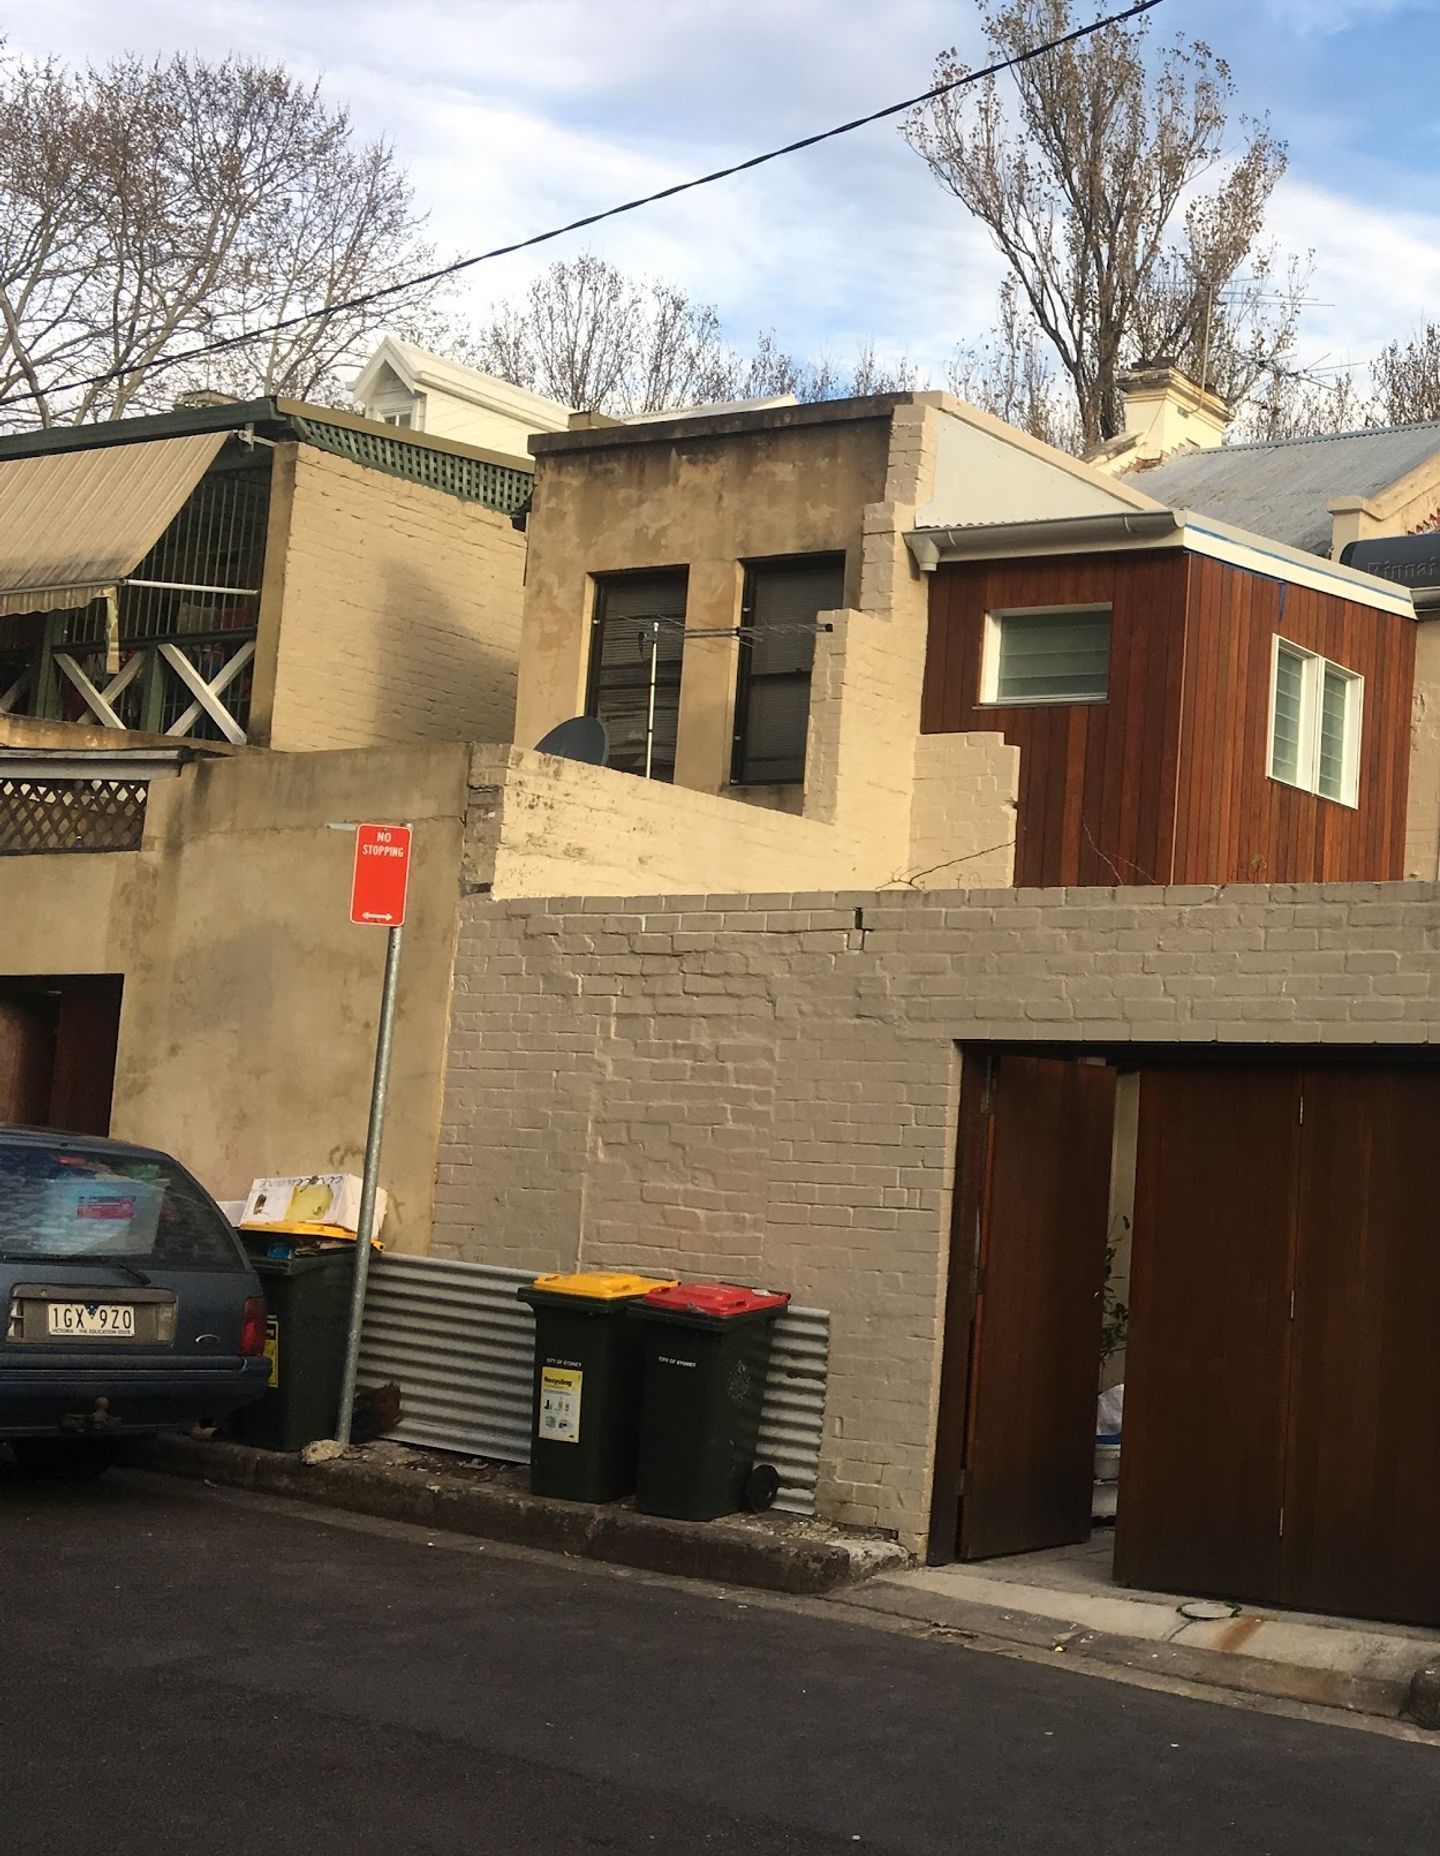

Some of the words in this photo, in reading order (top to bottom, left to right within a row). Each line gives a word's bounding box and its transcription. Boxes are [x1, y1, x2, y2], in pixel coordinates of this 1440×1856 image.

[1367, 556, 1437, 579] Rinnai
[376, 832, 392, 843] NO
[362, 844, 404, 858] STOPPING
[53, 1307, 85, 1328] 1GX
[544, 1376, 573, 1387] Recycling
